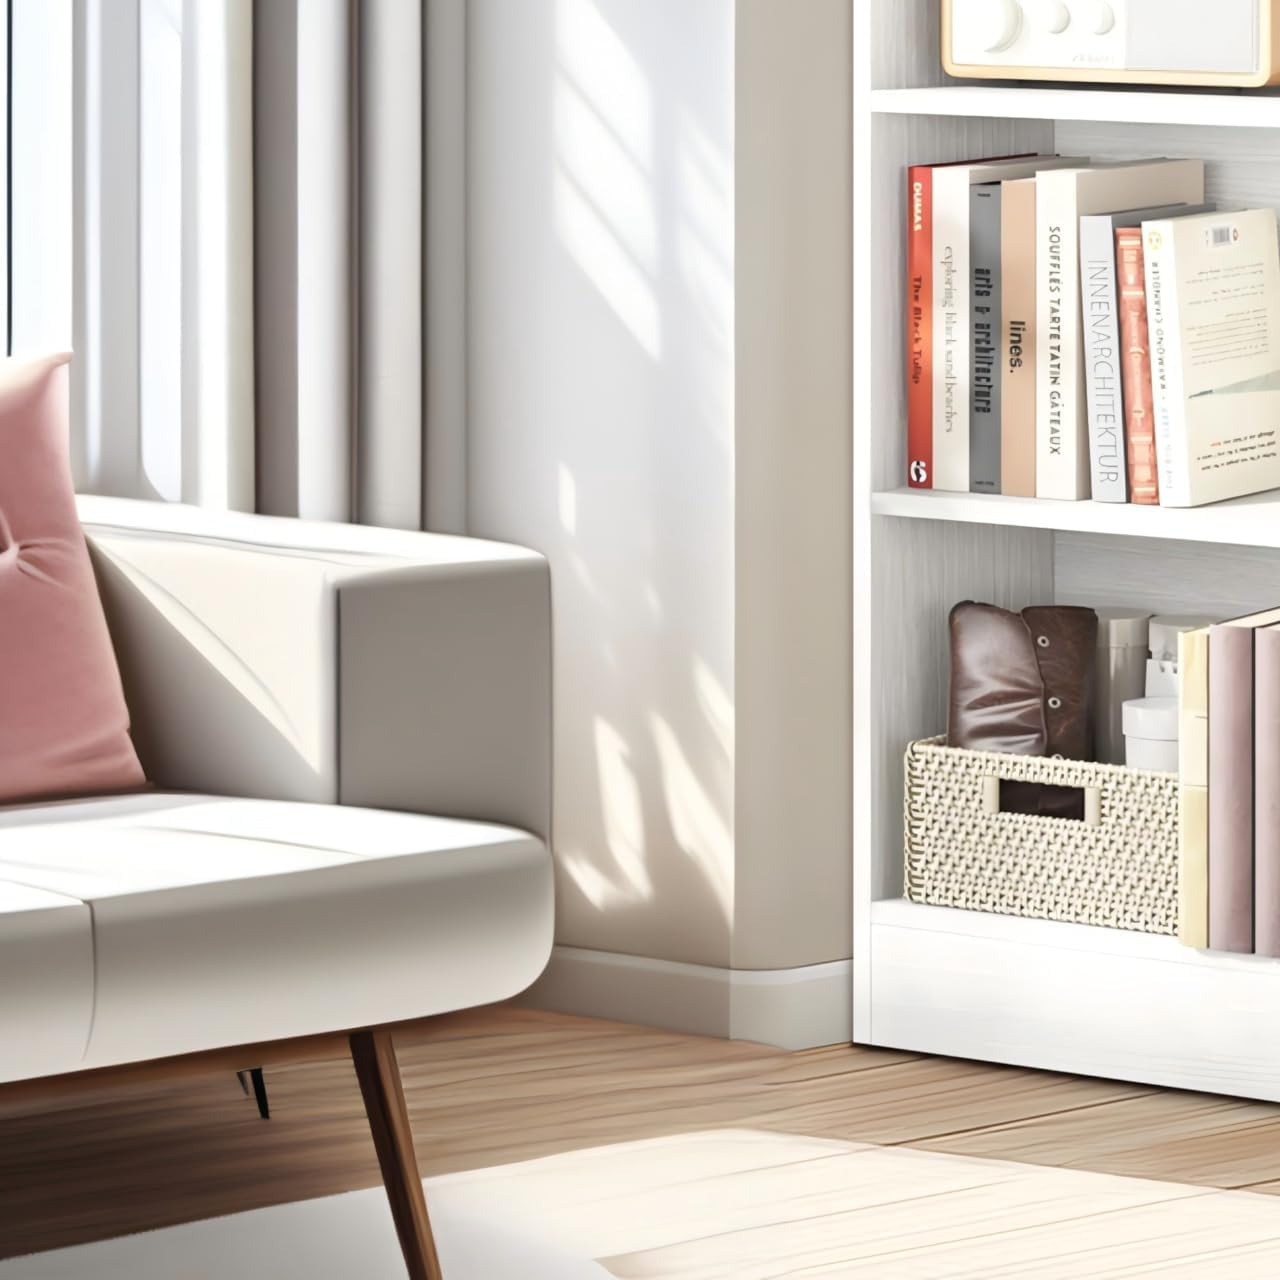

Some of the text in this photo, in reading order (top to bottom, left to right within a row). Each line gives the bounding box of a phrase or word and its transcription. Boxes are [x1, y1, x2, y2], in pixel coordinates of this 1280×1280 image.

[912, 181, 923, 232] DUMAS
[940, 246, 957, 307] exploring
[975, 268, 993, 296] arts
[1048, 226, 1064, 293] SOUFFLÉS
[913, 276, 923, 302] The
[1049, 298, 1061, 341] TARTE
[974, 323, 996, 414] architecture
[1009, 320, 1026, 374] lines.
[1049, 344, 1061, 386] TATIN
[1087, 260, 1118, 483] INNENARCHITEKTUR
